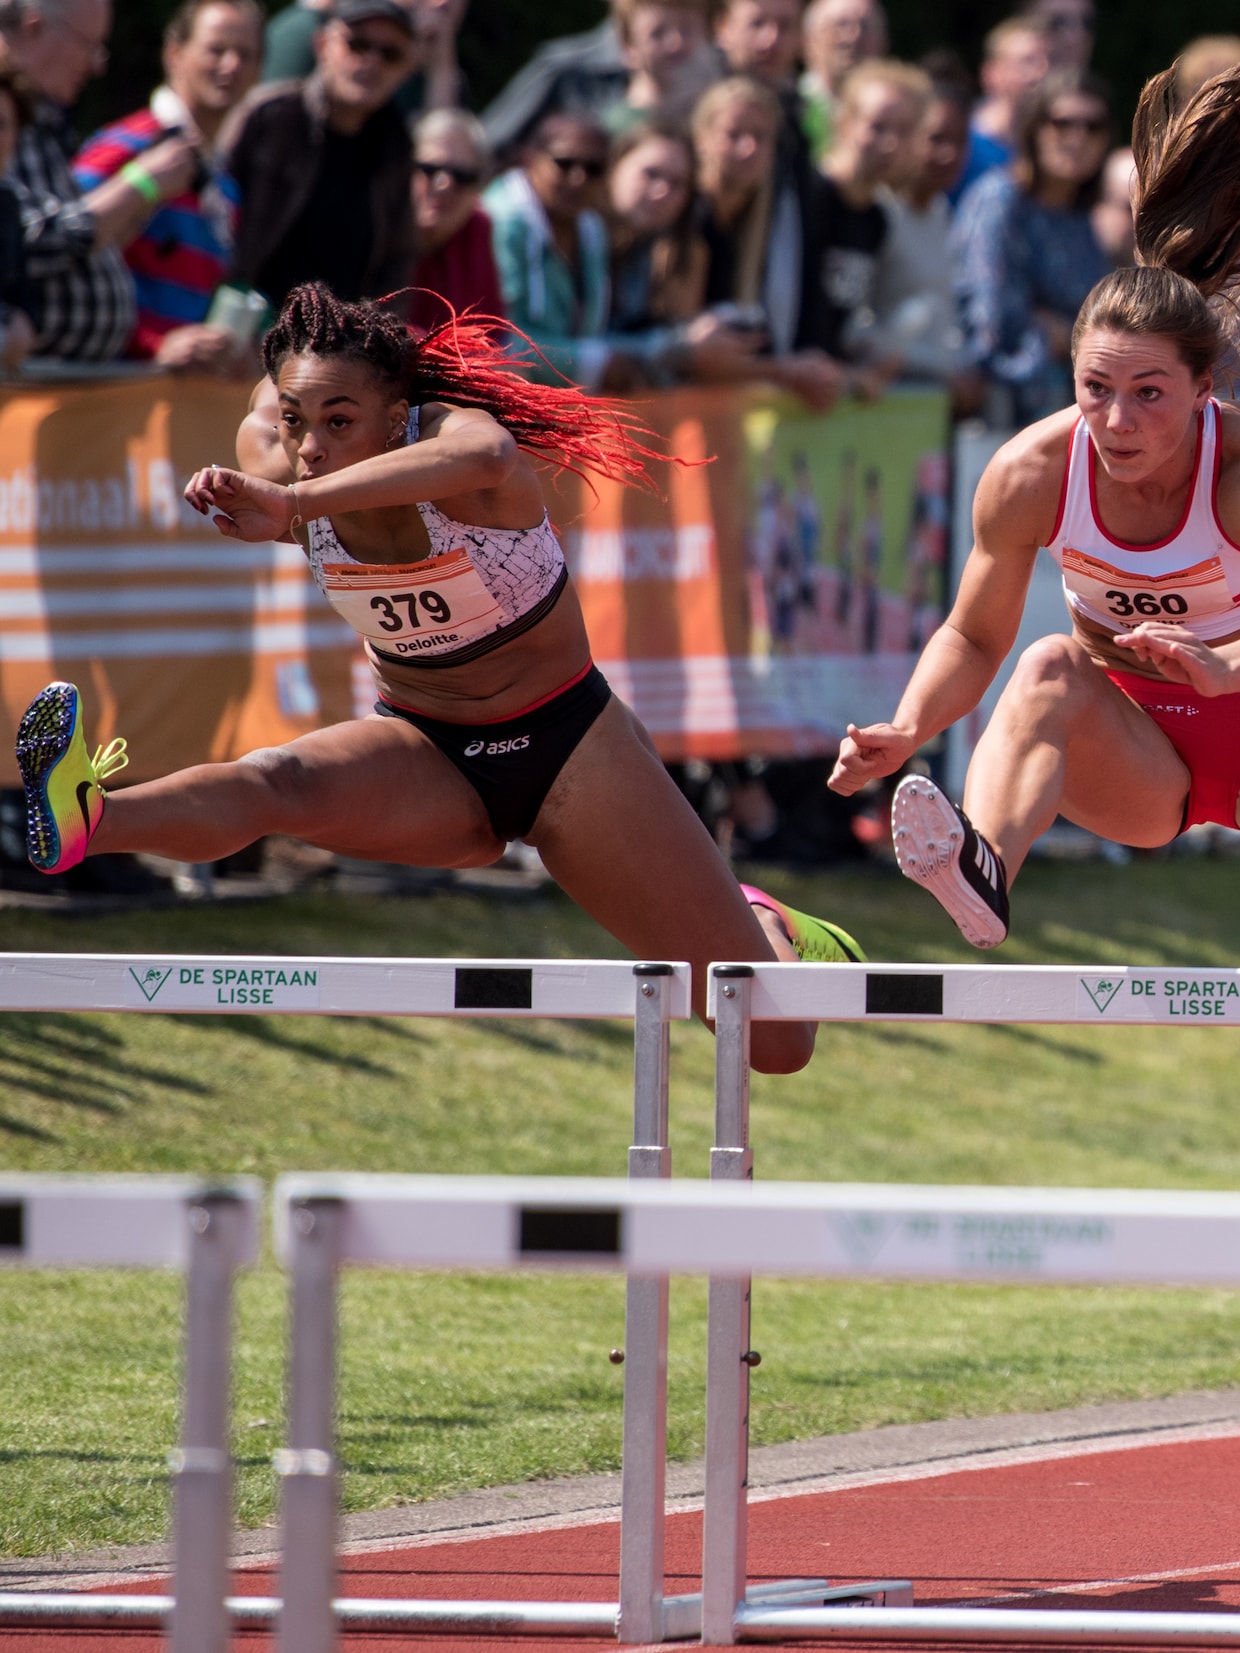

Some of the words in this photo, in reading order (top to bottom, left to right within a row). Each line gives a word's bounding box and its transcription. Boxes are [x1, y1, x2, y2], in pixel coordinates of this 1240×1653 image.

[370, 590, 451, 632] 379
[1105, 590, 1189, 616] 360
[486, 735, 530, 755] asics
[179, 968, 205, 984] DE
[212, 969, 317, 986] SPARTAAN
[217, 988, 274, 1004] LISSE
[1131, 980, 1156, 996] DE
[1169, 1000, 1226, 1016] LISSE
